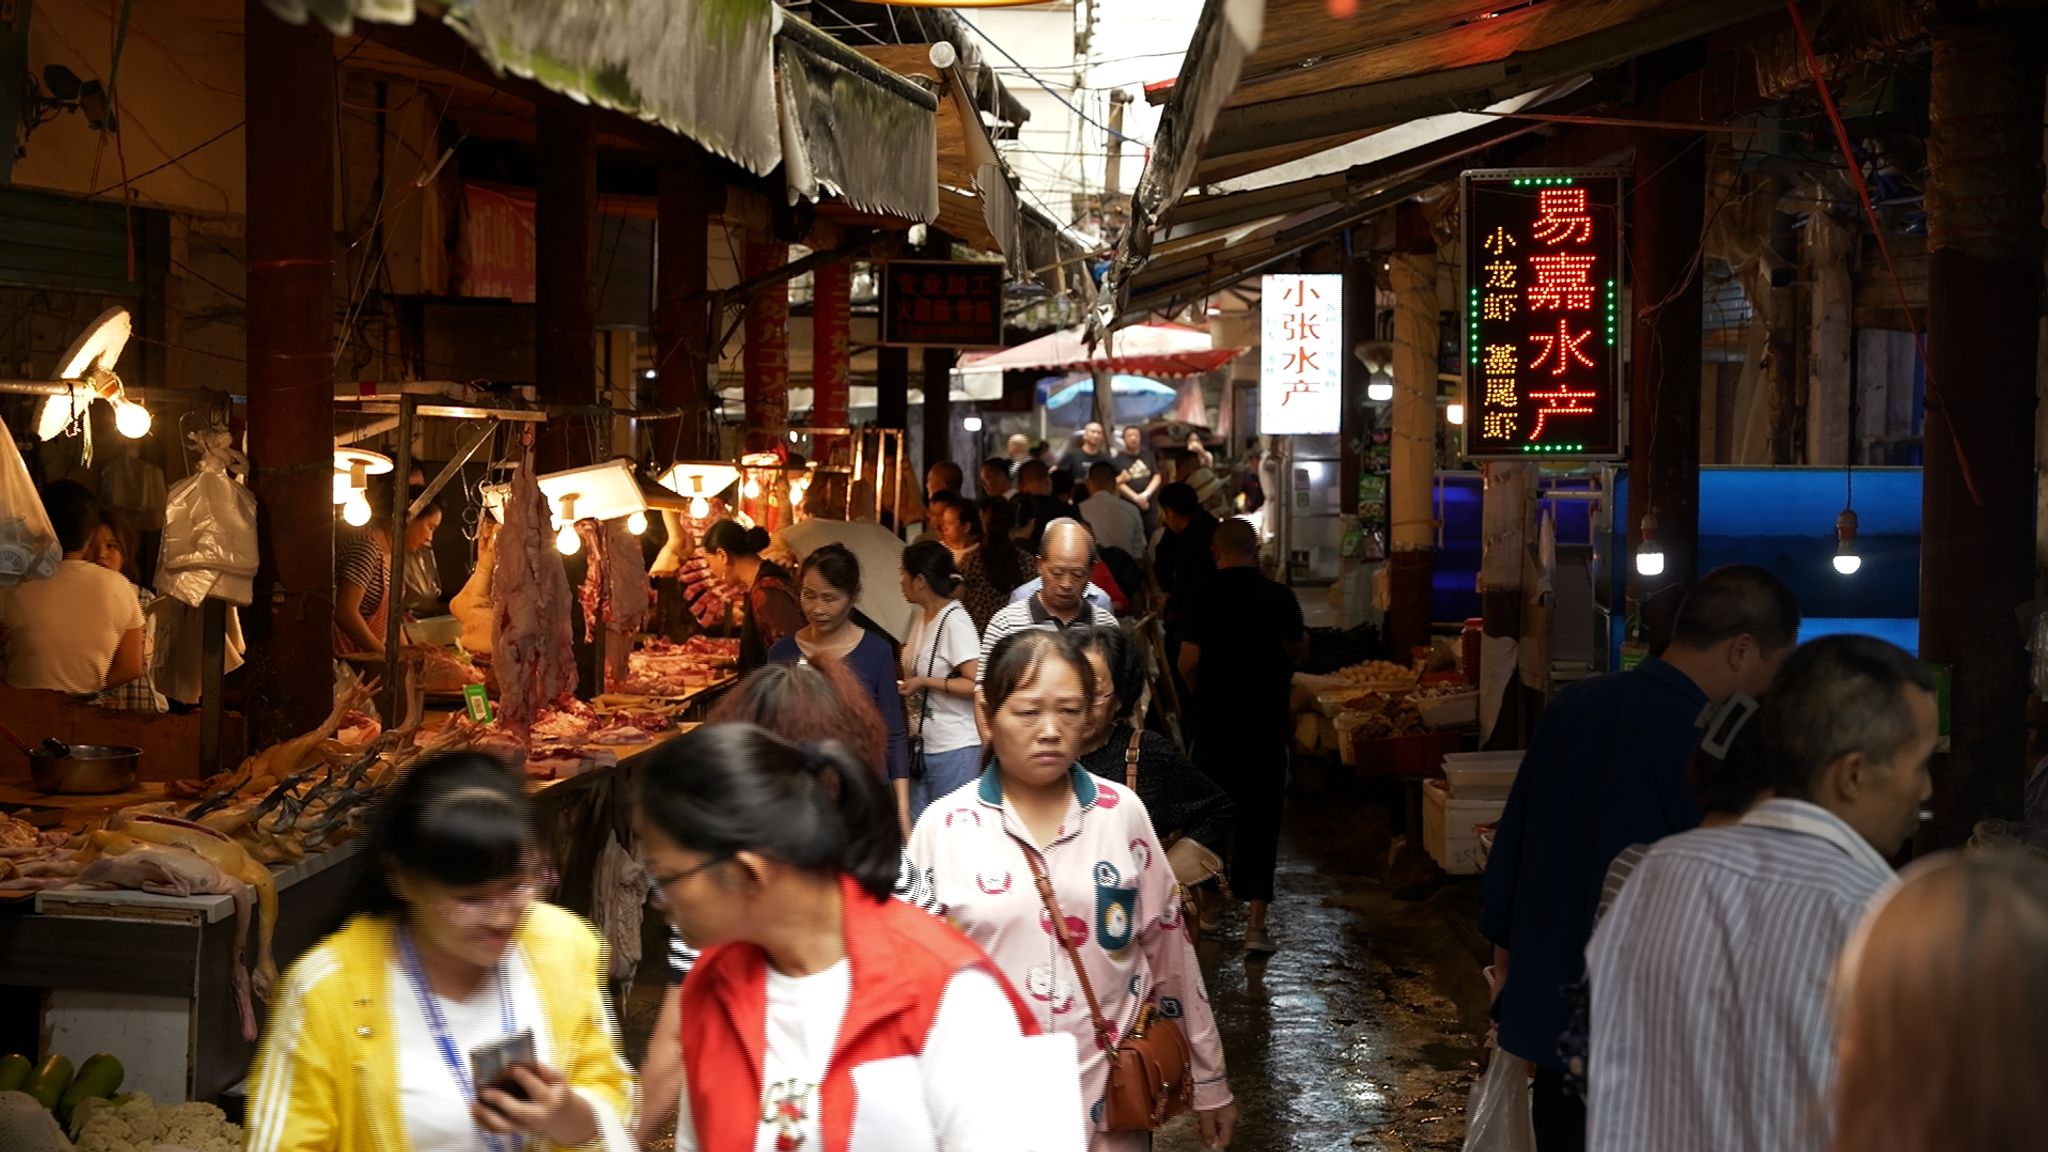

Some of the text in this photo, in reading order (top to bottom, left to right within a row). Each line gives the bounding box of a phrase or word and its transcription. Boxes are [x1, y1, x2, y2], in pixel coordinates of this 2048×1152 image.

[896, 271, 993, 297] 专业加工
[1482, 225, 1519, 322] 小龙虾
[1527, 188, 1597, 441] 易嘉水产
[1281, 279, 1321, 407] 小张水产
